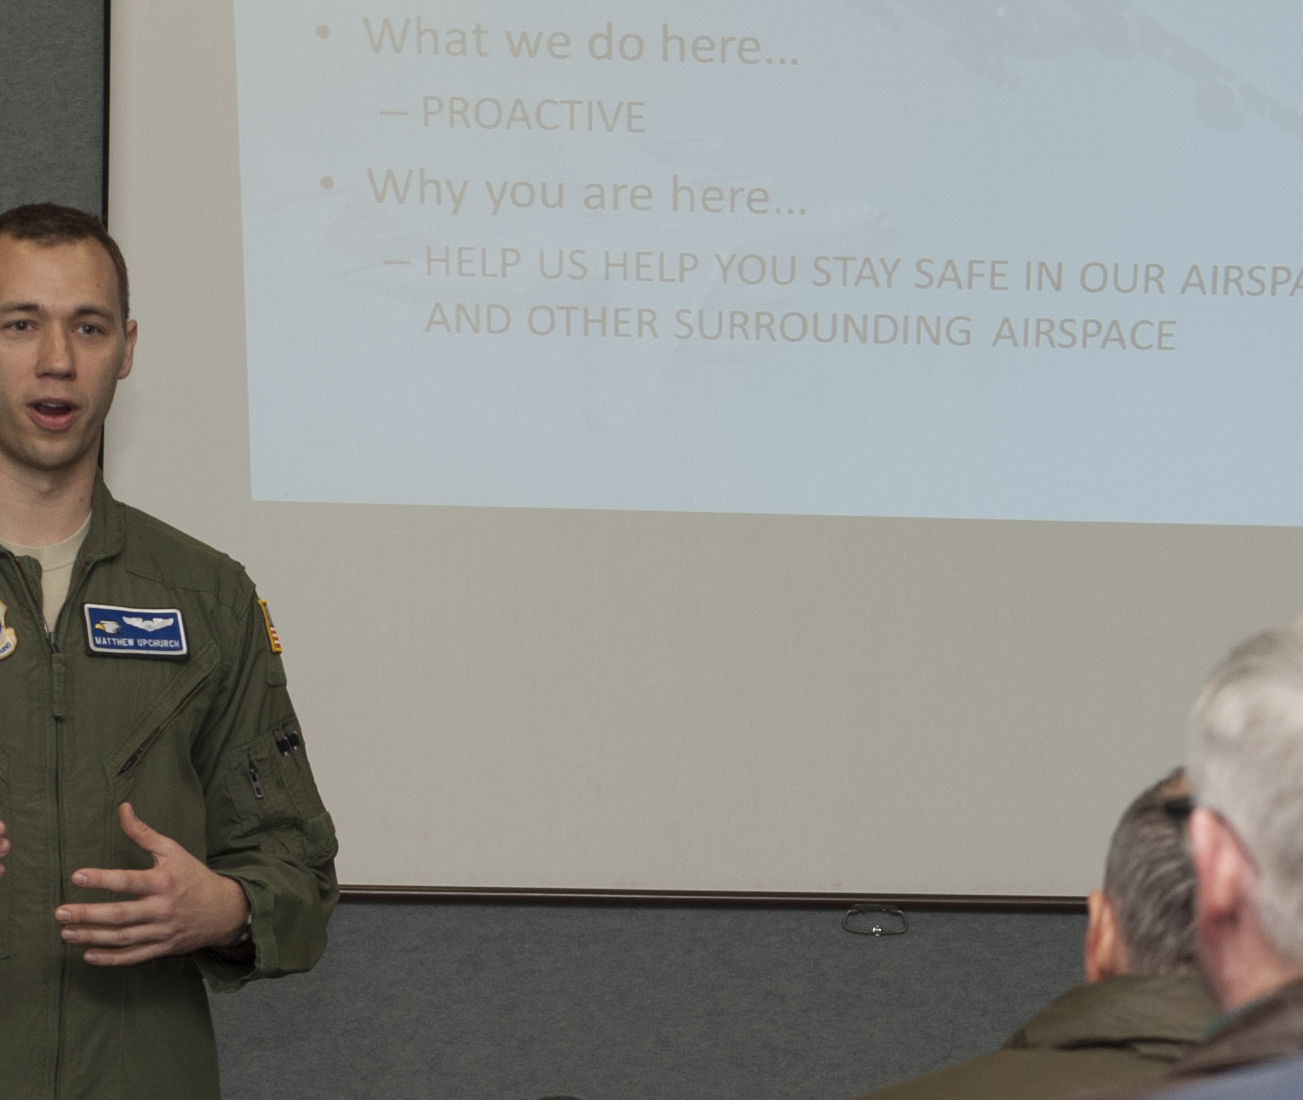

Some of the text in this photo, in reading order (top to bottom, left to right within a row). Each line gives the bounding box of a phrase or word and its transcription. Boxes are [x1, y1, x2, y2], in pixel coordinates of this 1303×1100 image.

[362, 15, 799, 65] What we do here...
[423, 95, 646, 133] PROACTIVE
[367, 167, 807, 216] Why you are here...
[426, 246, 521, 278] HELP
[539, 249, 588, 281] US
[604, 251, 699, 282] HELP
[715, 253, 797, 286] YOU
[812, 255, 902, 288] STAY
[914, 257, 1009, 291] SAFE
[1025, 260, 1064, 292] IN
[1080, 261, 1166, 294] OUR
[425, 302, 1178, 351] AND OTHER SURROUNDING AIRSPACE
[94, 636, 180, 648] MATTHEW UPCHURCH
